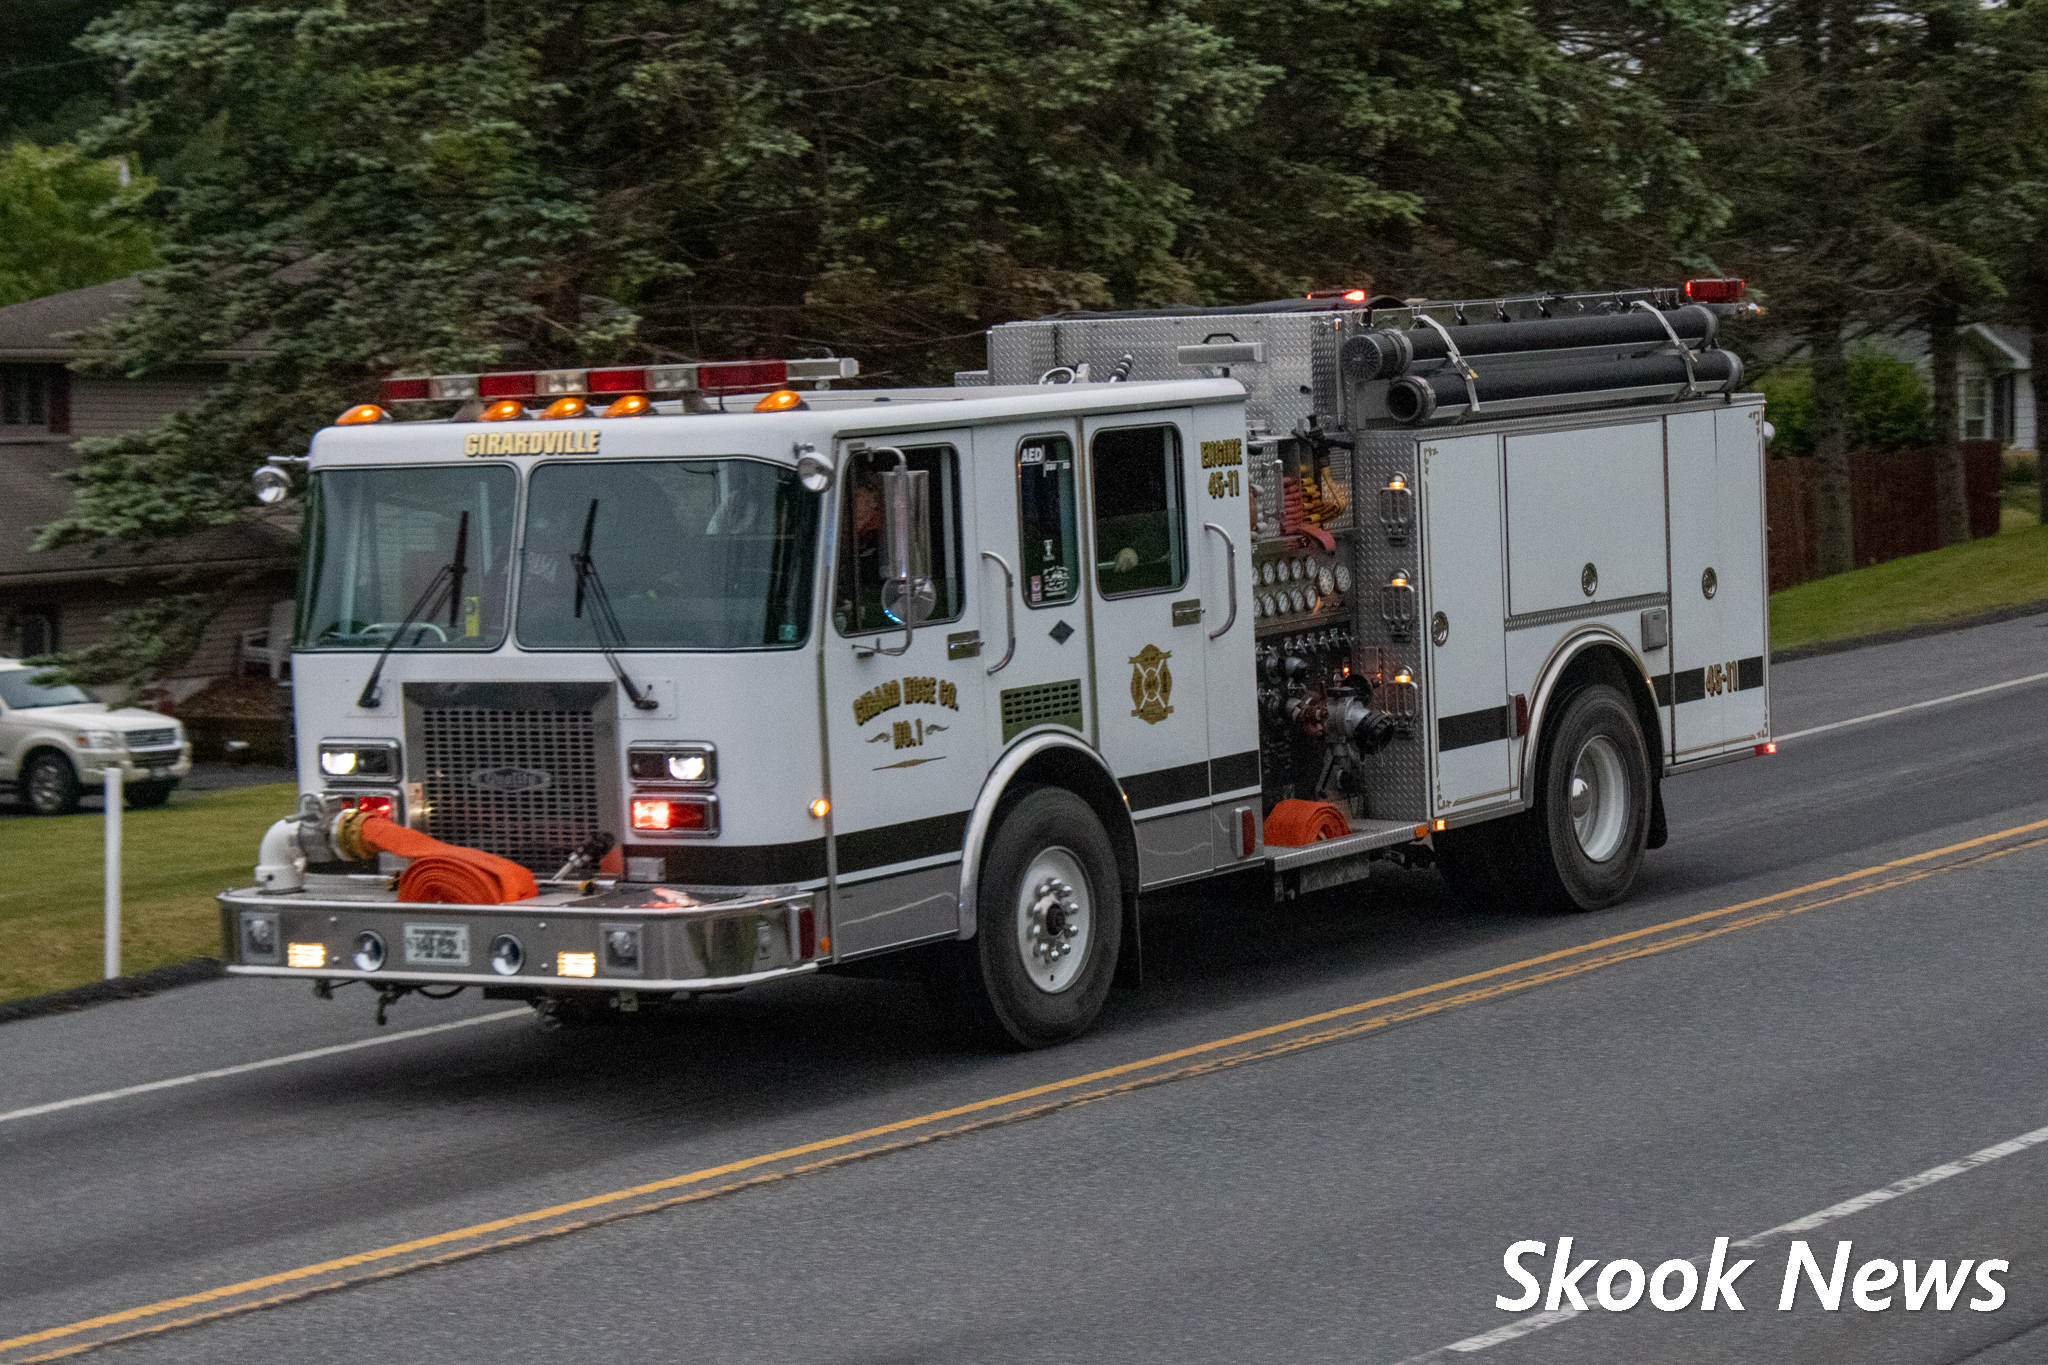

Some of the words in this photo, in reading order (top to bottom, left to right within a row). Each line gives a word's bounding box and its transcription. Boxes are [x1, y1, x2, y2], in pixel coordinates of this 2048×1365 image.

[464, 430, 600, 457] GIRARDVILLE
[1021, 447, 1043, 462] AED
[1200, 438, 1242, 469] ENGINE
[1208, 470, 1240, 499] 45-11
[1706, 660, 1738, 697] 45-11
